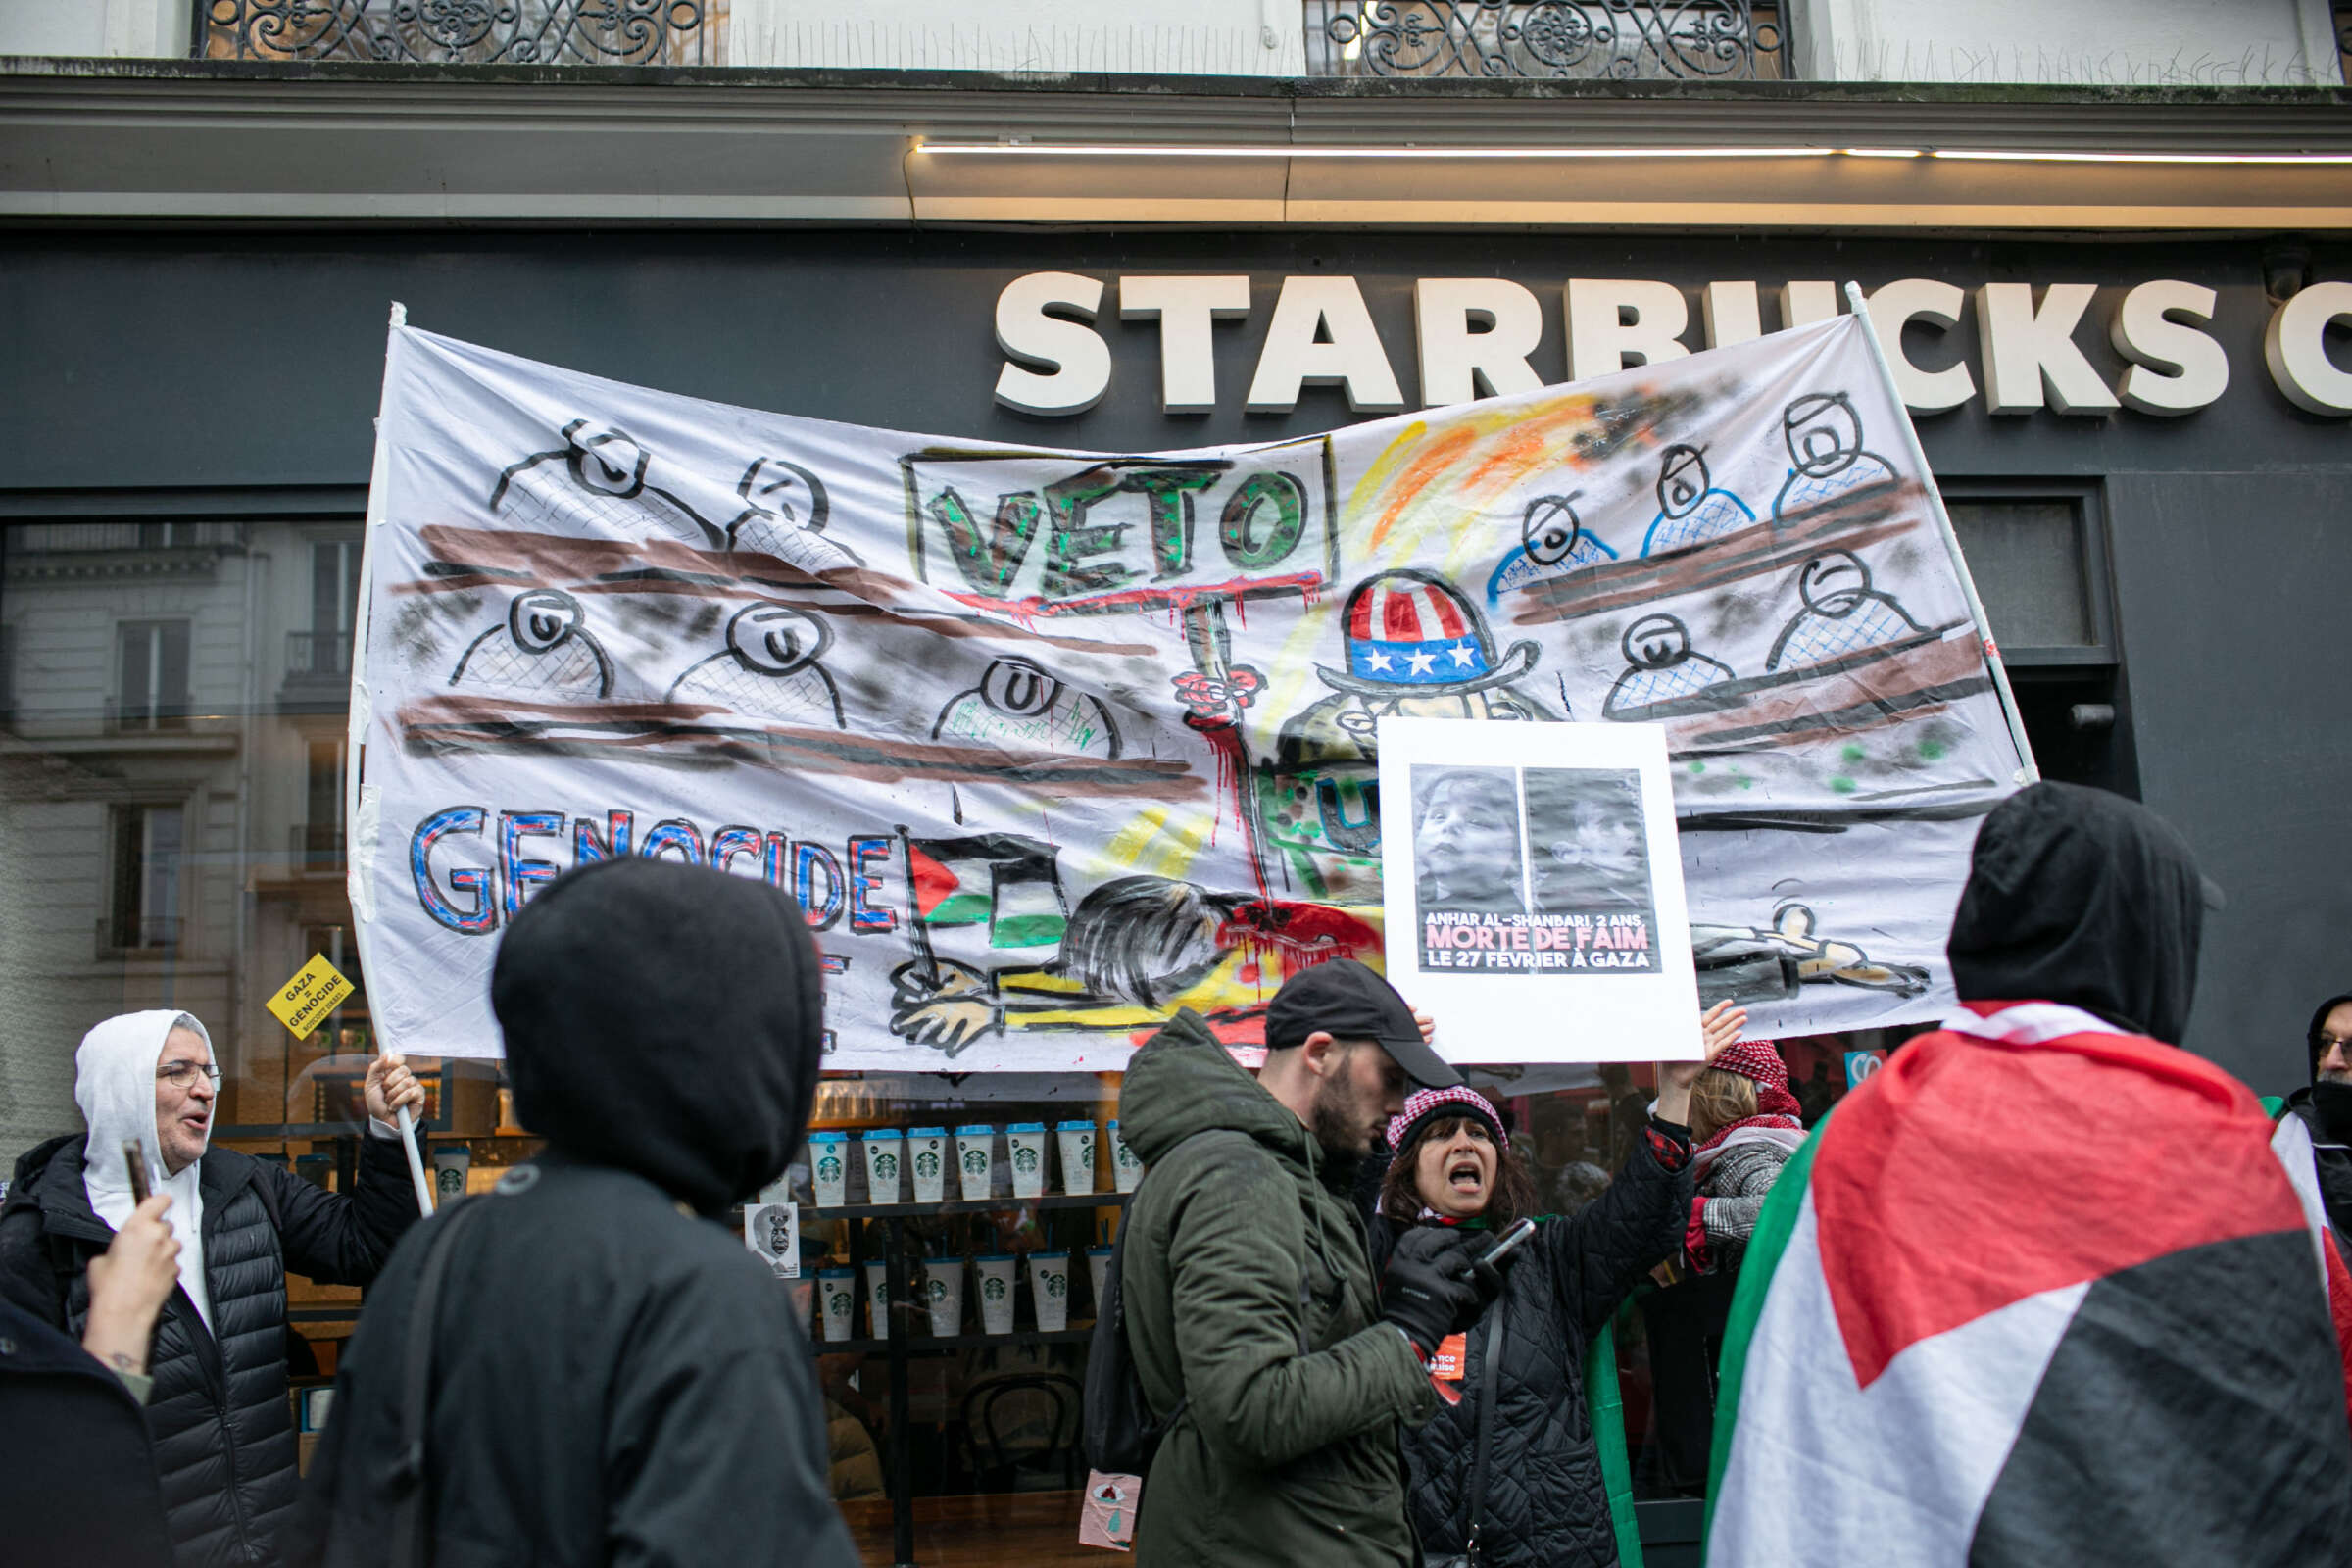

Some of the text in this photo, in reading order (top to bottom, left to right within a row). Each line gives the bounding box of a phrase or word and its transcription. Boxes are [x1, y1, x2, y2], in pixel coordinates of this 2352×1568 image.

[926, 461, 1308, 598] VETO
[1425, 912, 1646, 929] ANHAR AL-SHANBARI, 2 ANS,
[1426, 924, 1648, 950] MORTE DE FAIM
[1428, 947, 1650, 968] LE 27 FÉVRIER À GAZA
[285, 972, 316, 1001] GAZA
